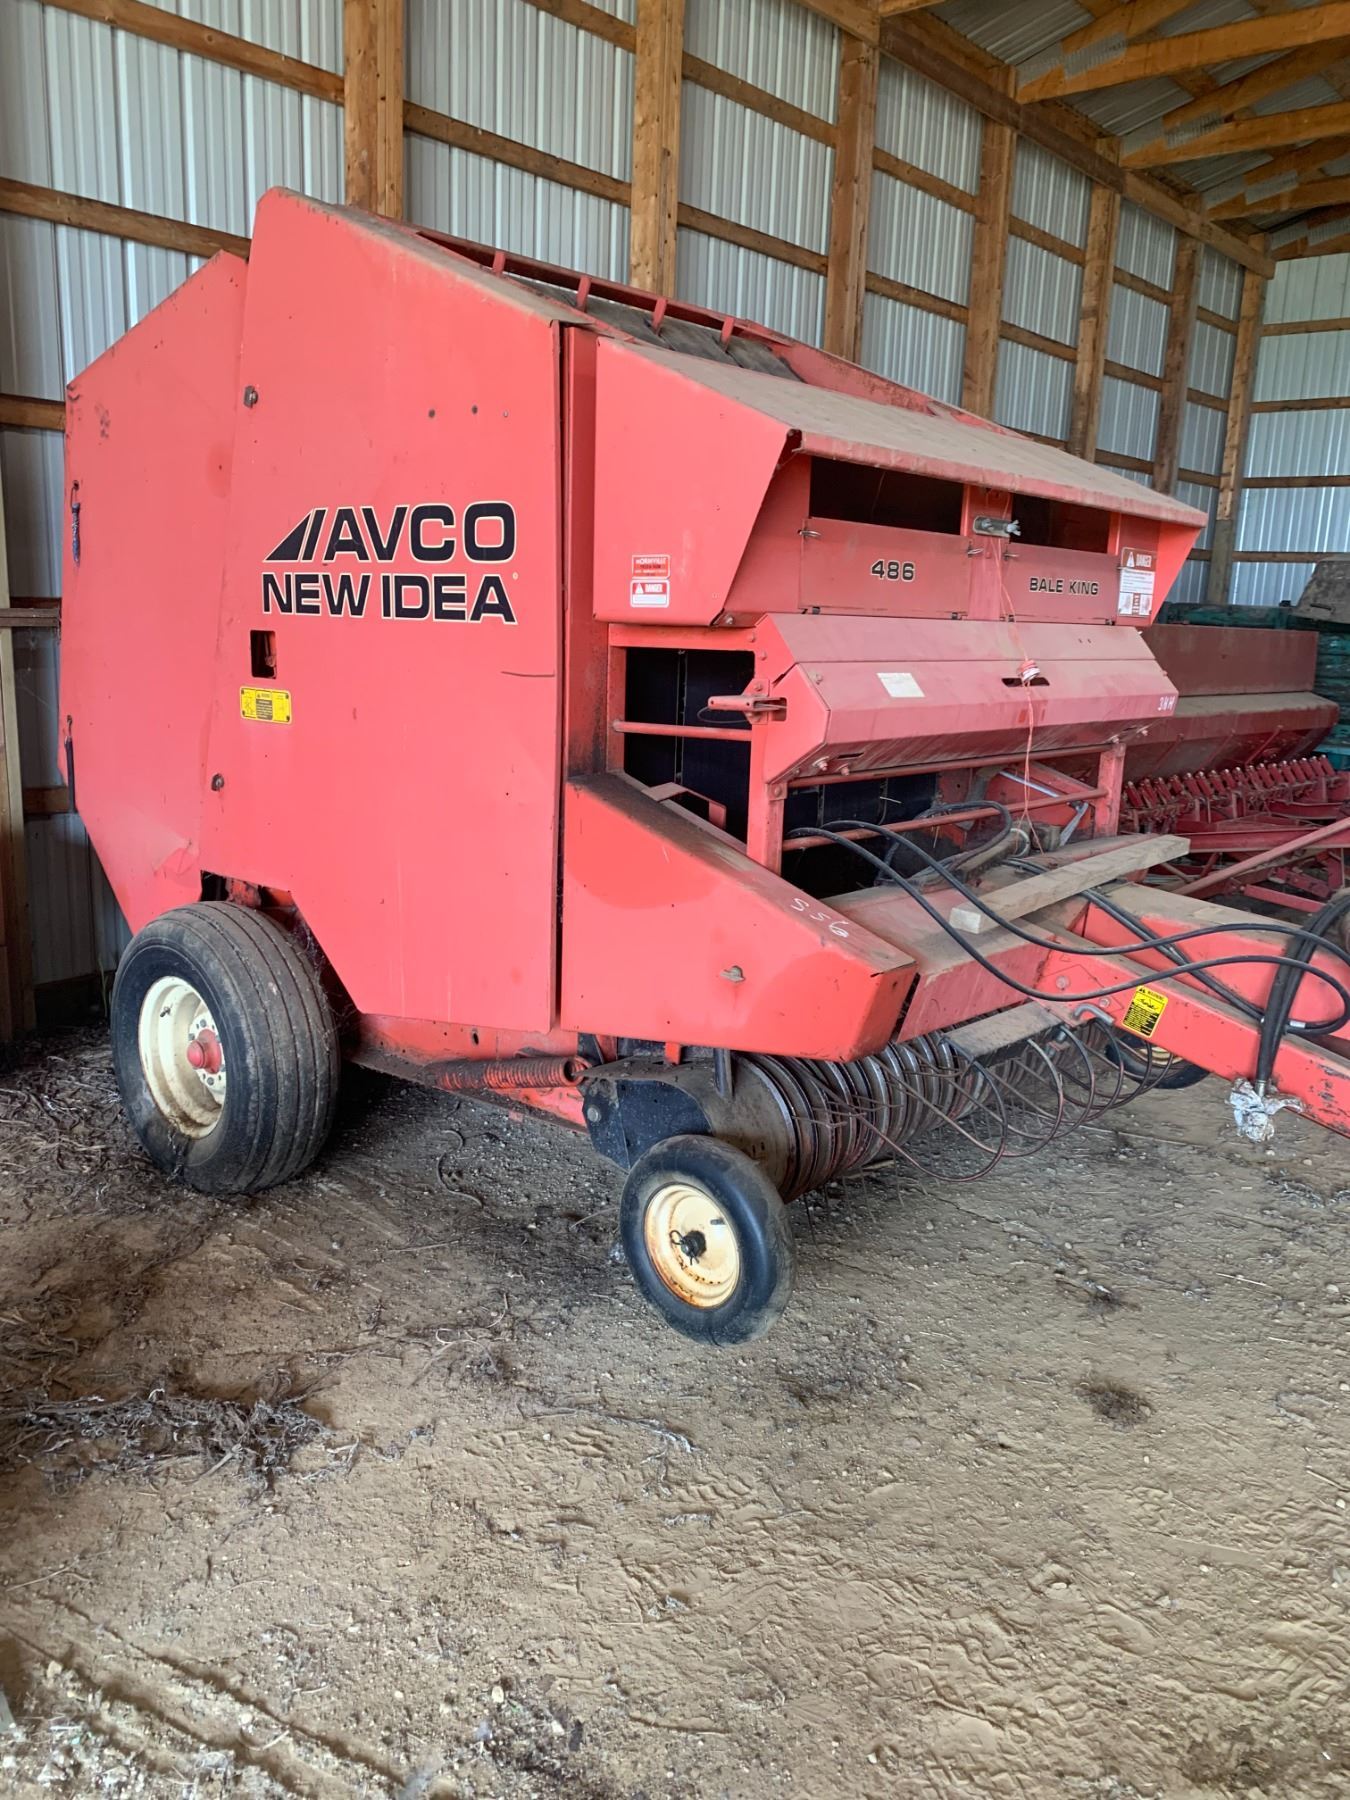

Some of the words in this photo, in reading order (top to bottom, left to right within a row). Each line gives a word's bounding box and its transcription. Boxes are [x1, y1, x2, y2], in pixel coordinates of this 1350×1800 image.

[321, 500, 517, 564] AVCO
[870, 559, 915, 583] 486
[1029, 577, 1065, 594] BALE
[1069, 580, 1100, 597] KING
[261, 571, 373, 618] NEW
[380, 572, 518, 625] IDEA
